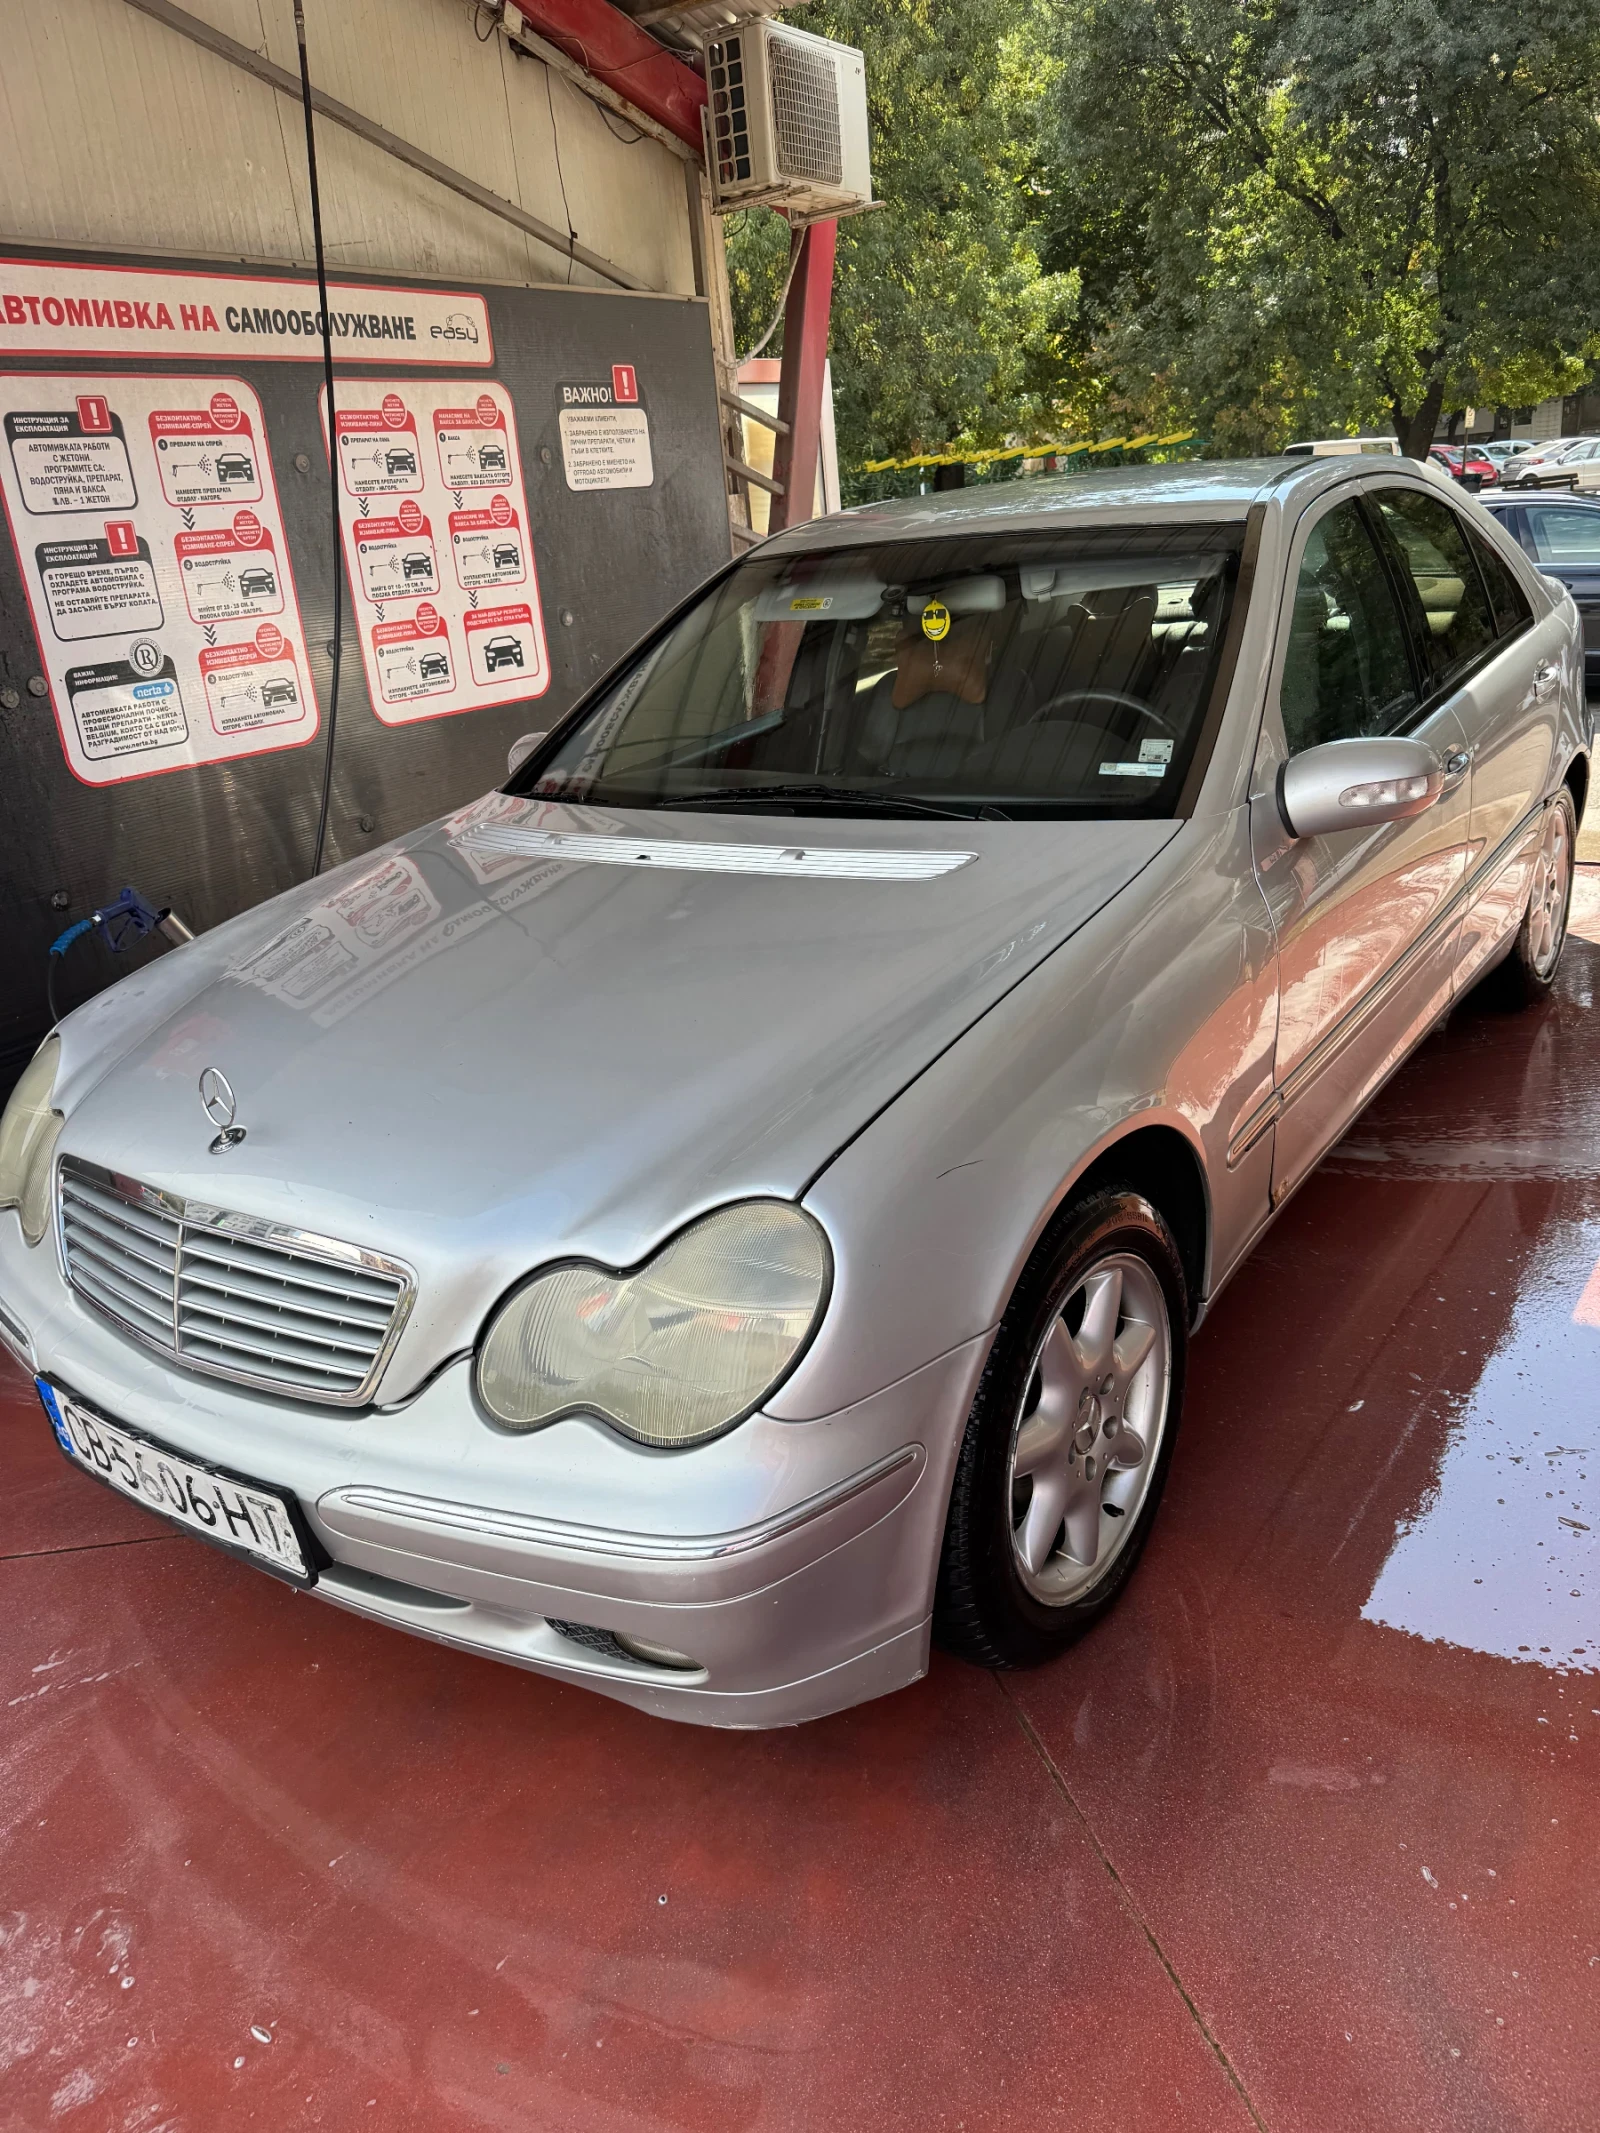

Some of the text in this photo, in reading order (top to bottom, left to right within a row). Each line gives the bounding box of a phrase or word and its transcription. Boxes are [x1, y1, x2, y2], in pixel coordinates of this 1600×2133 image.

[179, 304, 220, 332] НА
[430, 325, 478, 343] easy
[563, 387, 612, 403] ВАЖНО!
[29, 444, 81, 452] АВТОМИВКАТА
[44, 465, 92, 473] ПРОГРАМИТЕ
[30, 474, 123, 485] ВОДОСТРУЙКА, ПРЕПАРАТ,
[82, 485, 106, 493] ВАКСА
[44, 545, 88, 554] ИНСТРУКЦИЯ
[46, 553, 97, 562] ЕКСПЛОАТАЦИЯ
[50, 580, 88, 588] ОХЛАДЕТЕ
[90, 574, 138, 584] АВТОМОБИЛА
[55, 572, 85, 580] ГОРЕЩО
[87, 569, 113, 577] ВРЕМЕ,
[52, 582, 144, 596] ПРОГРАМА ВОДОСТРУЙКА.
[66, 595, 108, 606] ОСТАВЯЙТЕ
[110, 592, 150, 601] ПРЕПАРАТА
[57, 608, 67, 616] ДА
[69, 604, 102, 614] ЗАСЪХНЕ
[105, 602, 126, 610] ВЪРХУ
[137, 687, 162, 698] nerta
[82, 706, 132, 719] АВТОМИВКАТА
[134, 701, 160, 710] РАБОТИ
[83, 711, 144, 726] ПРОФЕСИОНАЛНИ
[85, 712, 178, 733] ТВАЩИ ПРЕПАРАТИ NERTA
[120, 726, 143, 735] КОИТО
[88, 733, 142, 748] РАЗГРАДИМОСТ
[114, 739, 158, 752] www.nerta.bg
